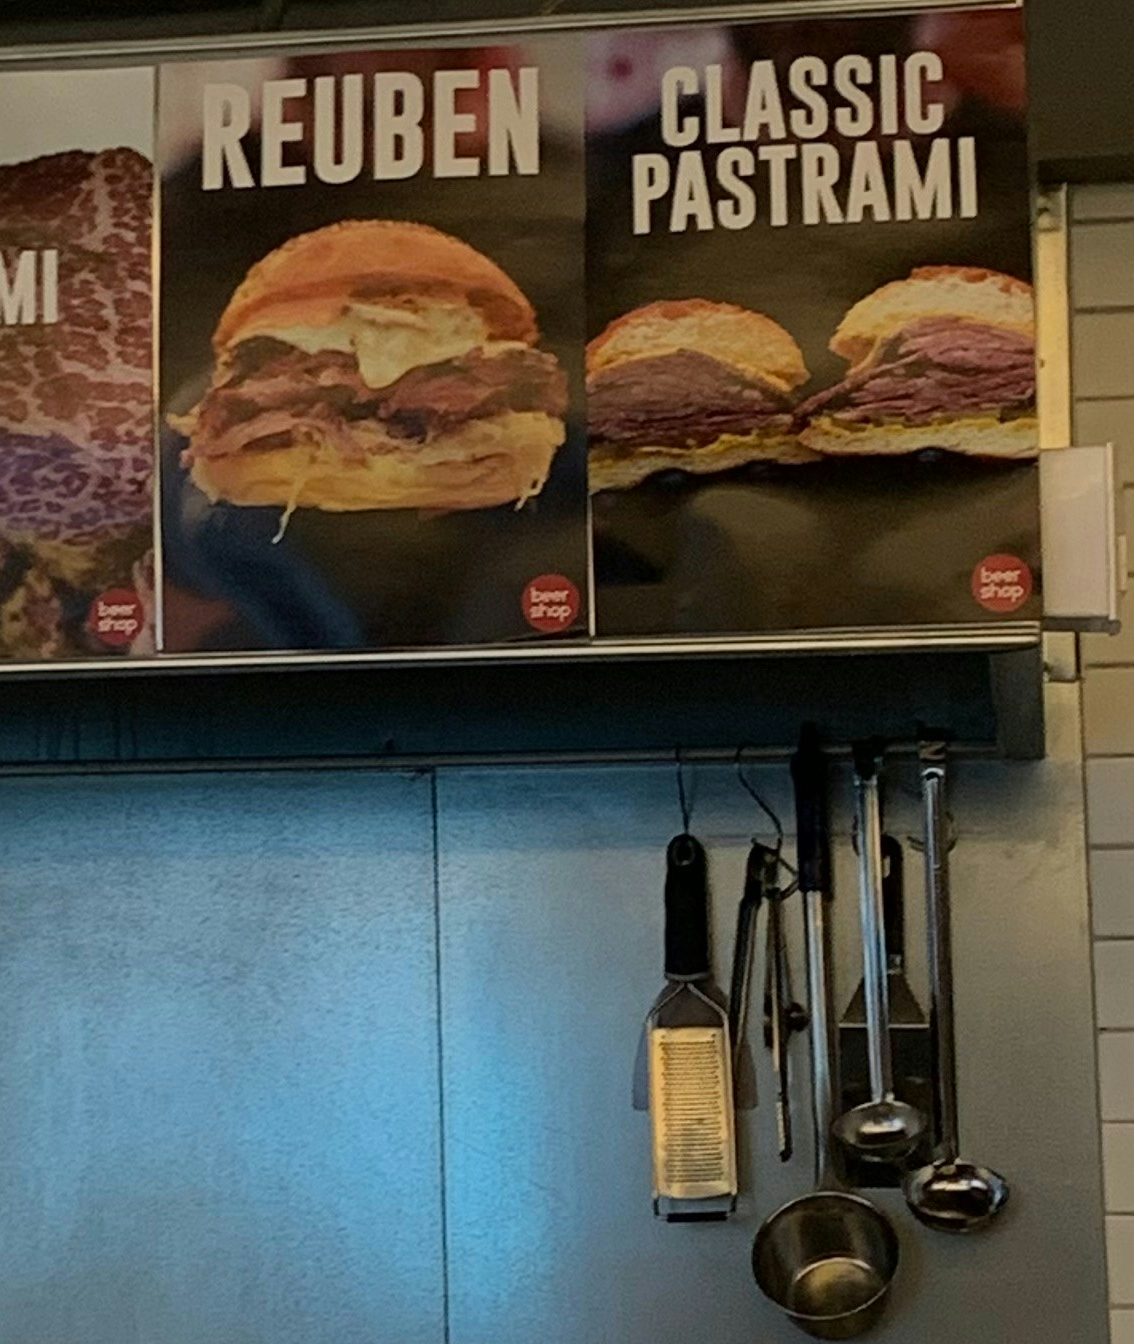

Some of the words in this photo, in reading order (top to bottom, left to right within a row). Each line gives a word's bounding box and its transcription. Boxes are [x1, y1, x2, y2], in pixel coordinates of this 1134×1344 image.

[661, 51, 944, 147] CLASSIC
[201, 67, 541, 190] REUBEN
[632, 136, 978, 235] PASTRAMI
[980, 566, 1021, 583] beer
[530, 587, 569, 603] beer
[979, 583, 1024, 603] shop
[98, 601, 136, 617] beer
[529, 603, 572, 623] shop
[98, 617, 138, 636] shop
